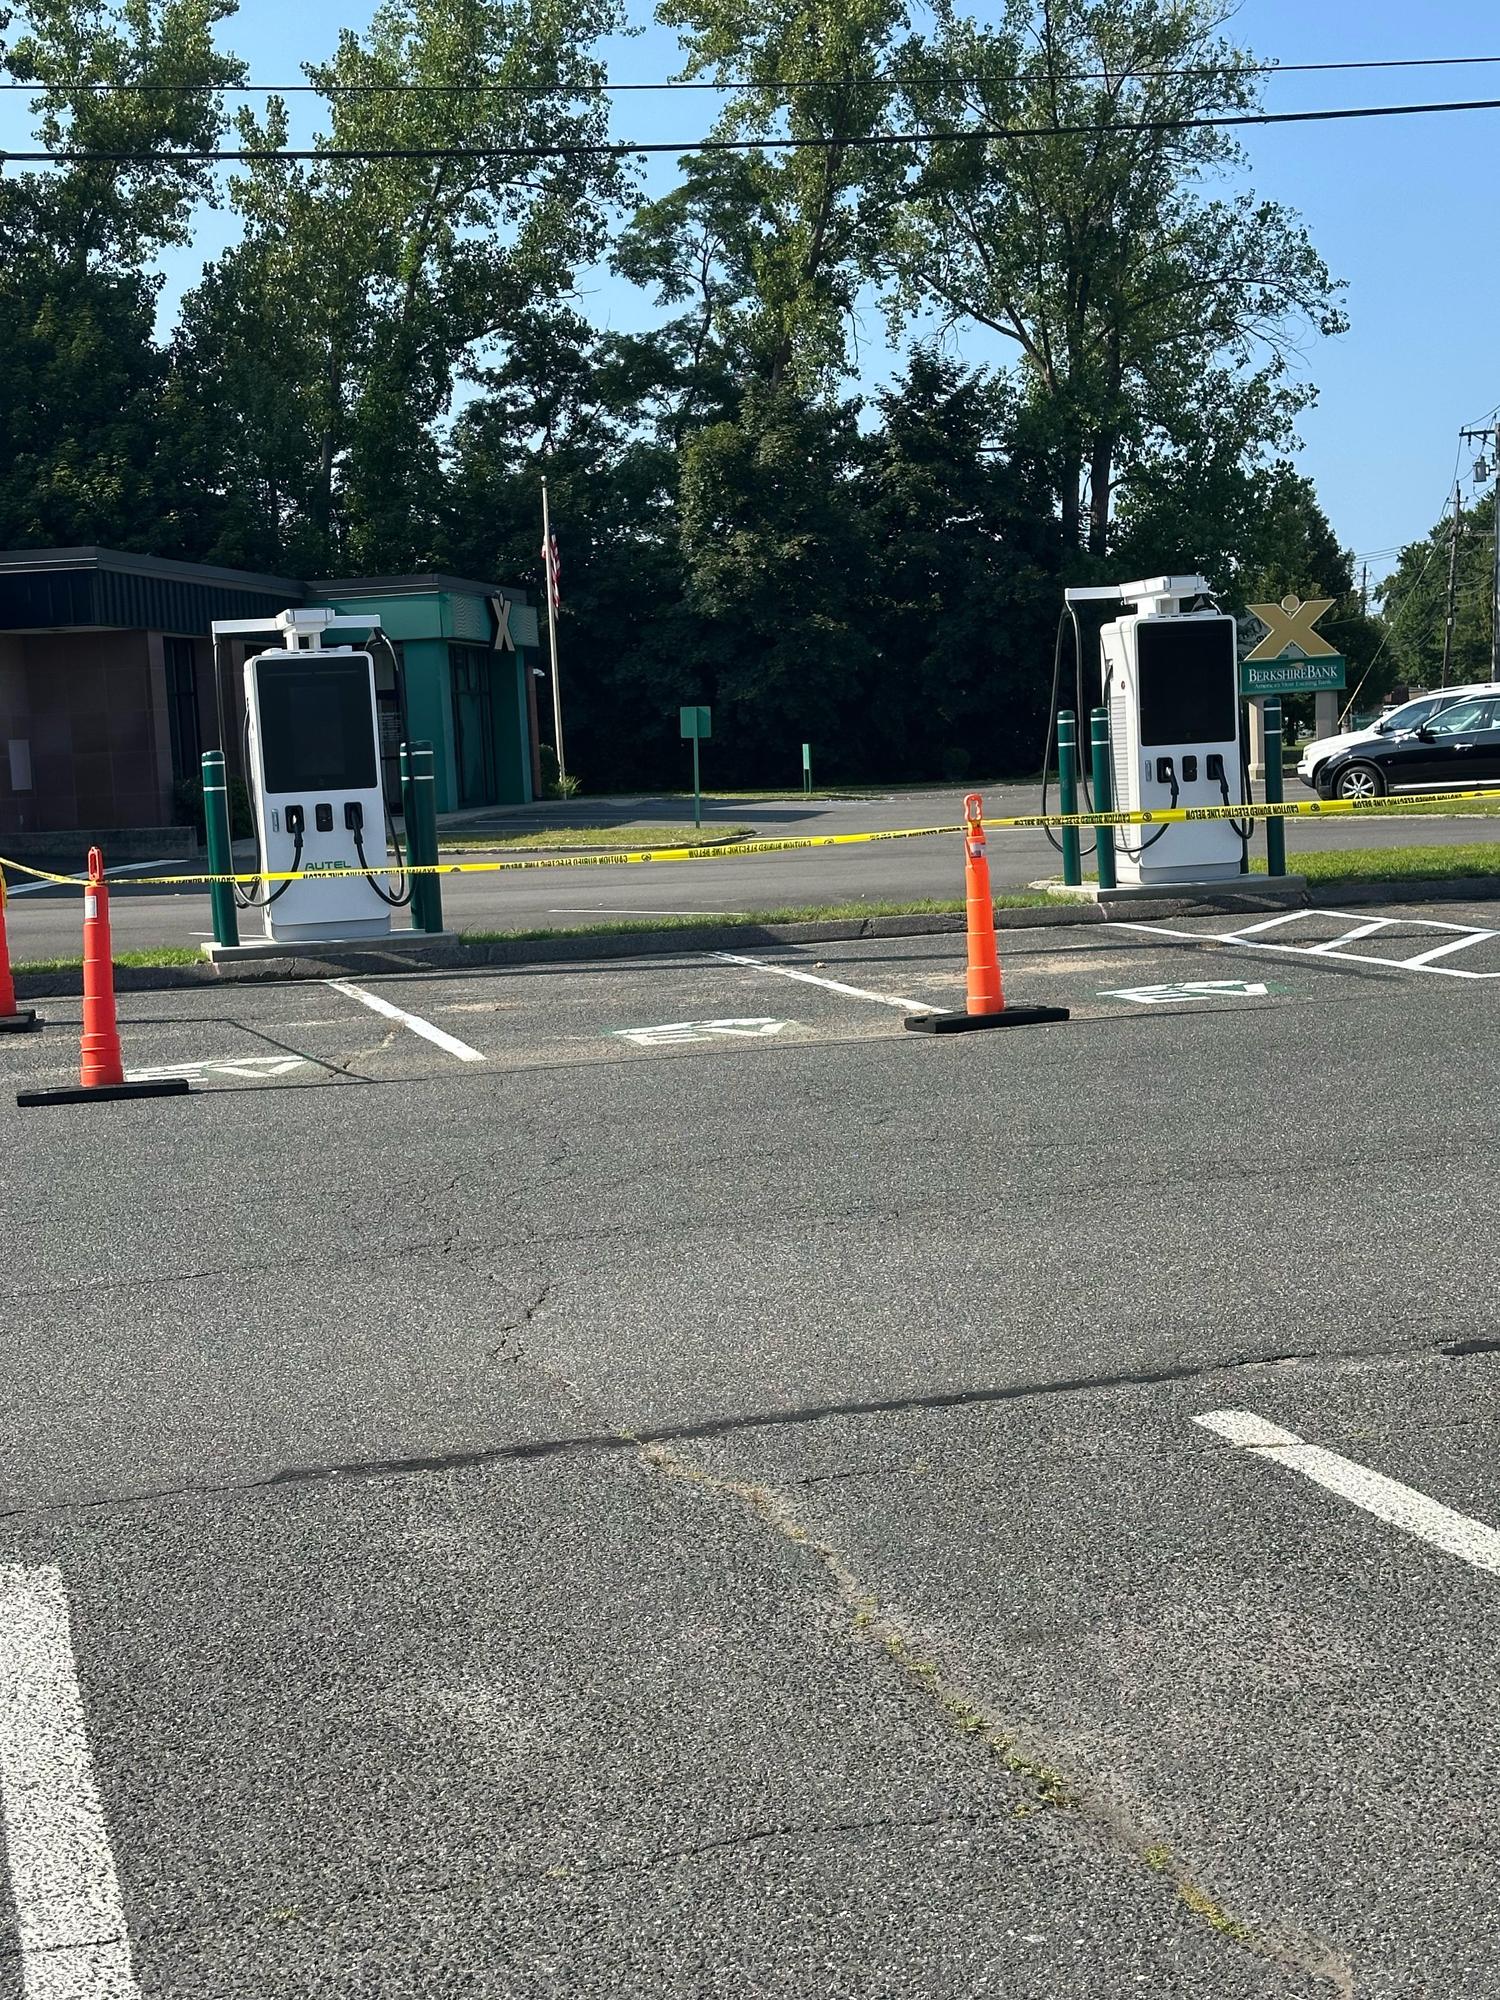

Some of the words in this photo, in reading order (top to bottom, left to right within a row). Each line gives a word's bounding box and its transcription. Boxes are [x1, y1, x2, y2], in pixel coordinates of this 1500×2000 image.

[1373, 799, 1387, 807] LINE
[1207, 808, 1221, 818] LINE
[1222, 807, 1250, 817] ELECTRIC
[1251, 806, 1272, 815] BURIED
[1273, 804, 1299, 814] CAUTION
[1081, 815, 1103, 824] BURIED
[1104, 814, 1130, 823] CAUTION
[1186, 810, 1206, 820] BELOW
[1052, 816, 1080, 825] ELECTRIC
[305, 860, 351, 871] AUTEL
